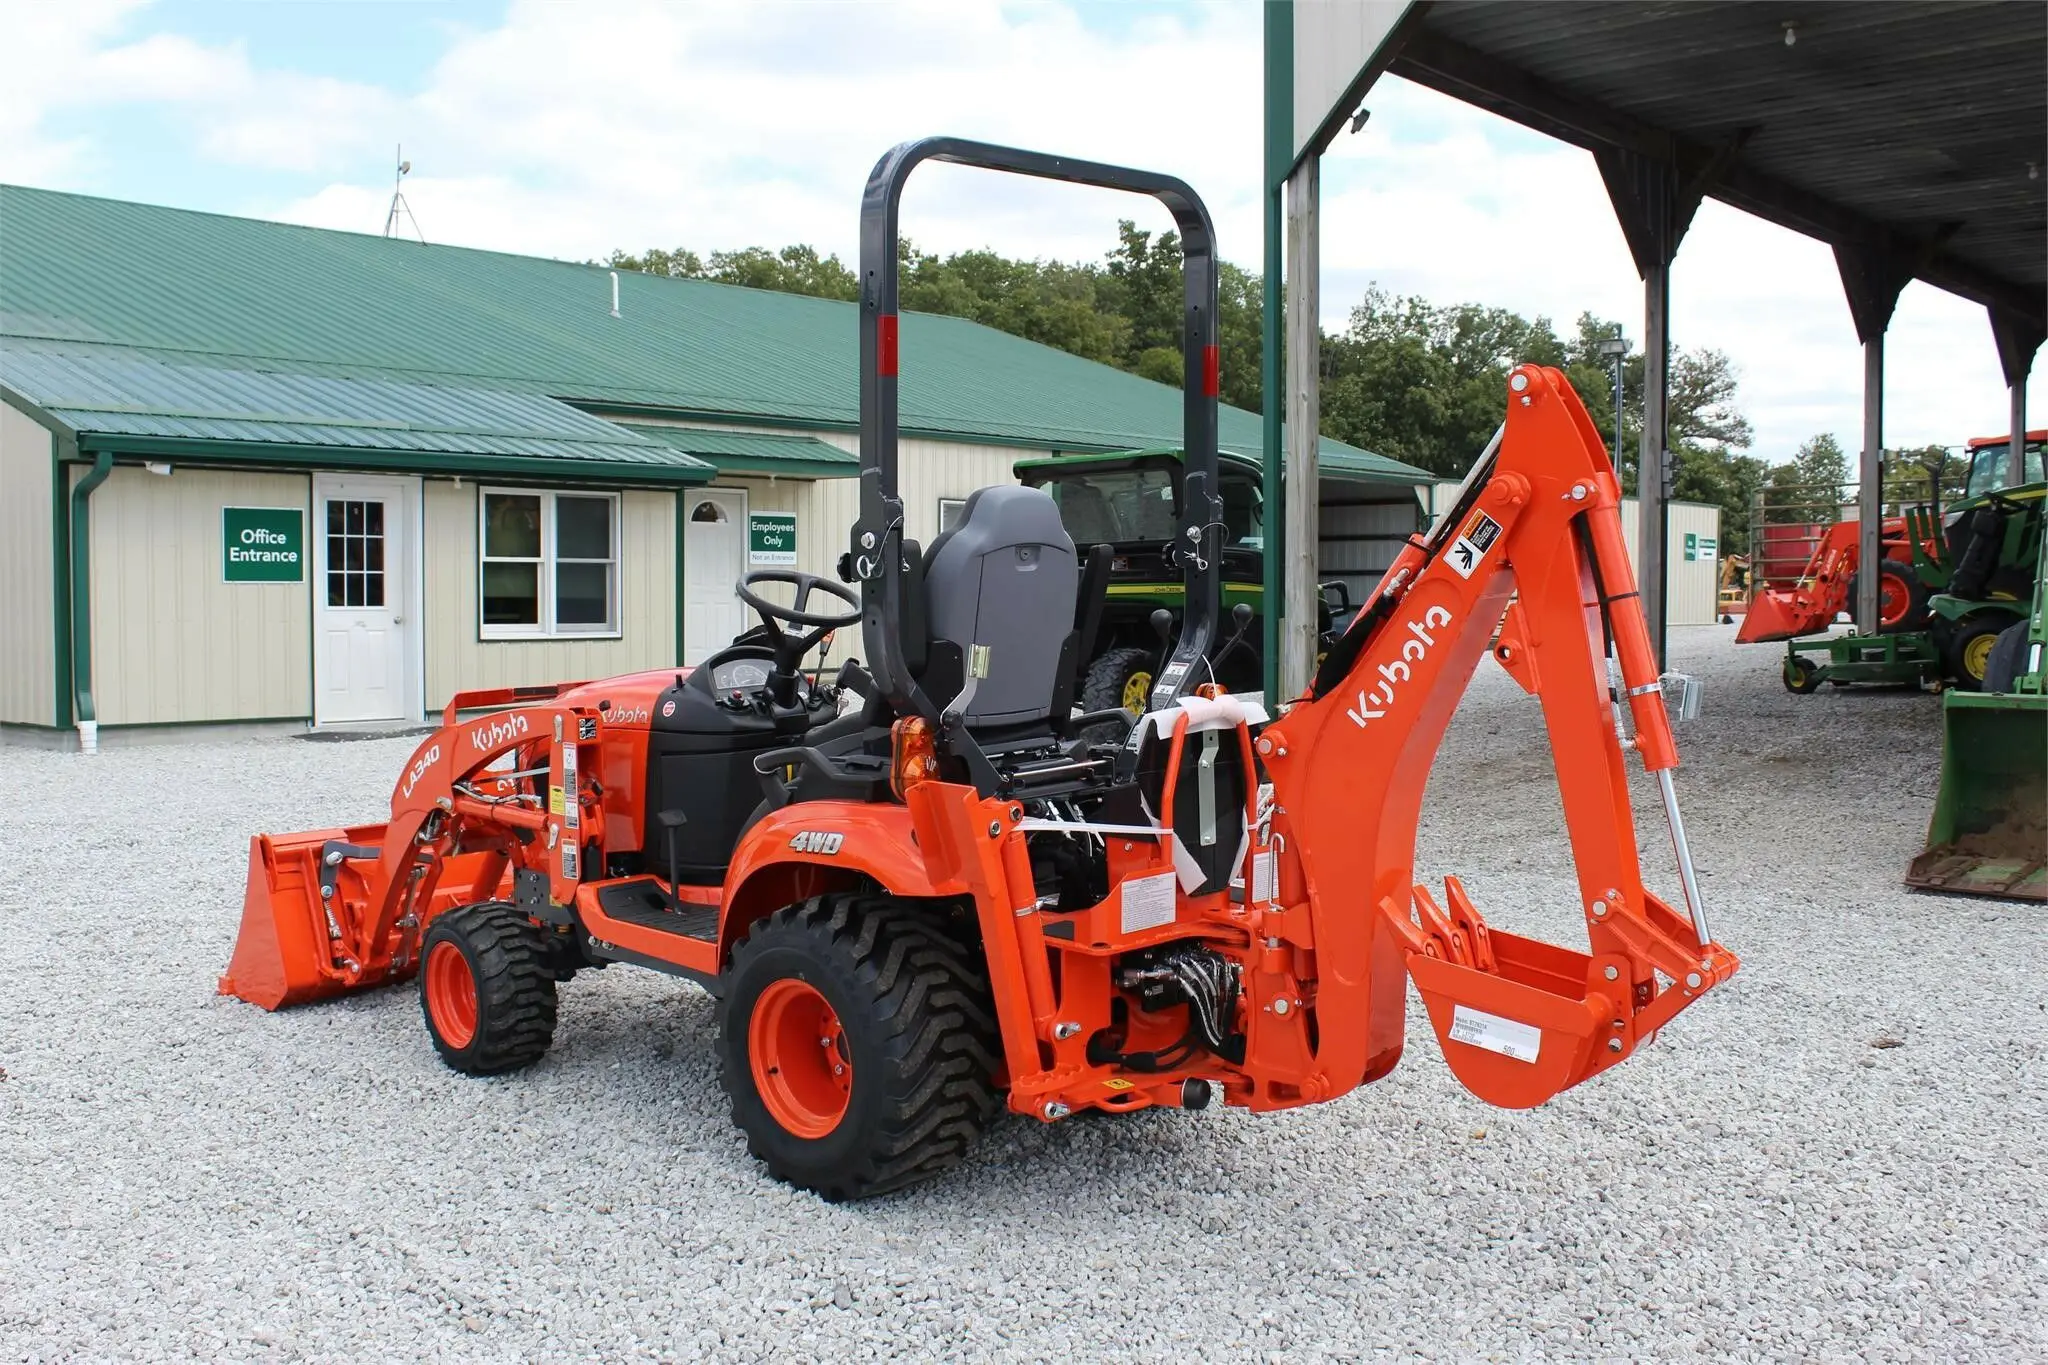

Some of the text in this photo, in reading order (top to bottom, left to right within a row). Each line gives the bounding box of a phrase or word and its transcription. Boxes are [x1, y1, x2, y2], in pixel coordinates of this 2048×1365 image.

[751, 521, 795, 534] Employees
[241, 528, 287, 545] Office
[763, 535, 783, 548] Only
[229, 546, 299, 562] Entrance
[752, 553, 763, 561] Not
[1346, 605, 1453, 729] Kubota
[471, 712, 529, 752] Kubota
[402, 744, 440, 799] LA340
[788, 830, 844, 855] 4WD
